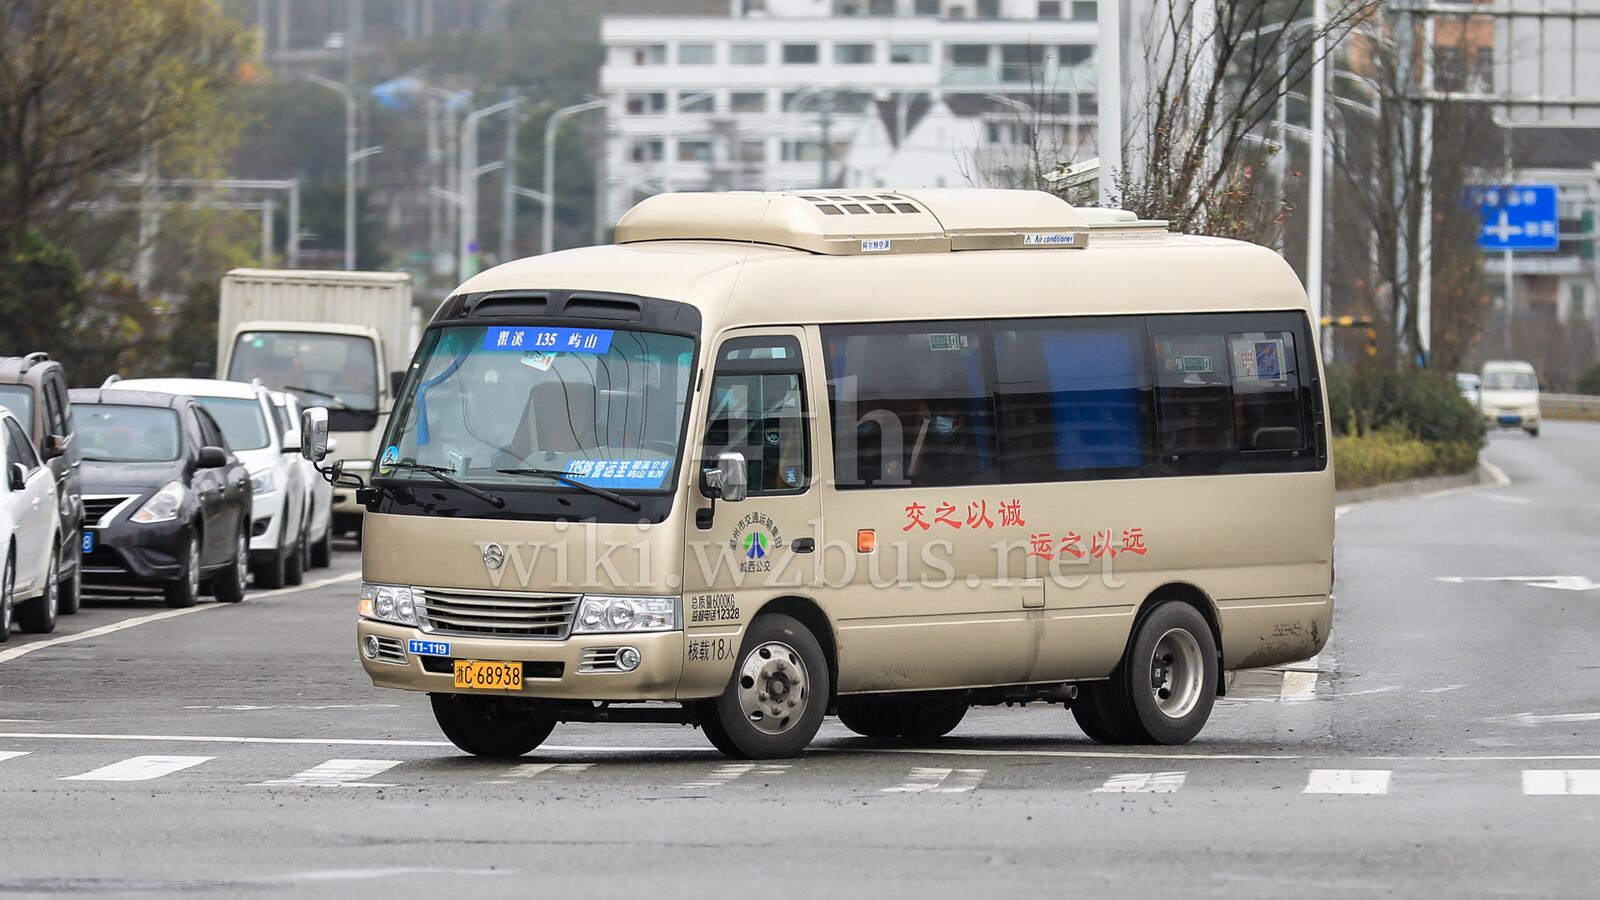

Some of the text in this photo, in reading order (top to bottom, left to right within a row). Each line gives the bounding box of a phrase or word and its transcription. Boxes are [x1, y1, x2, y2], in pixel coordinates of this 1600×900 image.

[497, 331, 598, 349] 瞿溪 135 屿山
[903, 499, 1026, 532] 交之以诚
[729, 511, 783, 551] 温州市交通运输集团
[1027, 528, 1148, 560] 运之以远
[740, 560, 771, 573] 城西公交
[691, 594, 735, 610] 总质量6000KG
[411, 641, 447, 654] 11-119
[687, 638, 735, 661] 核载18人
